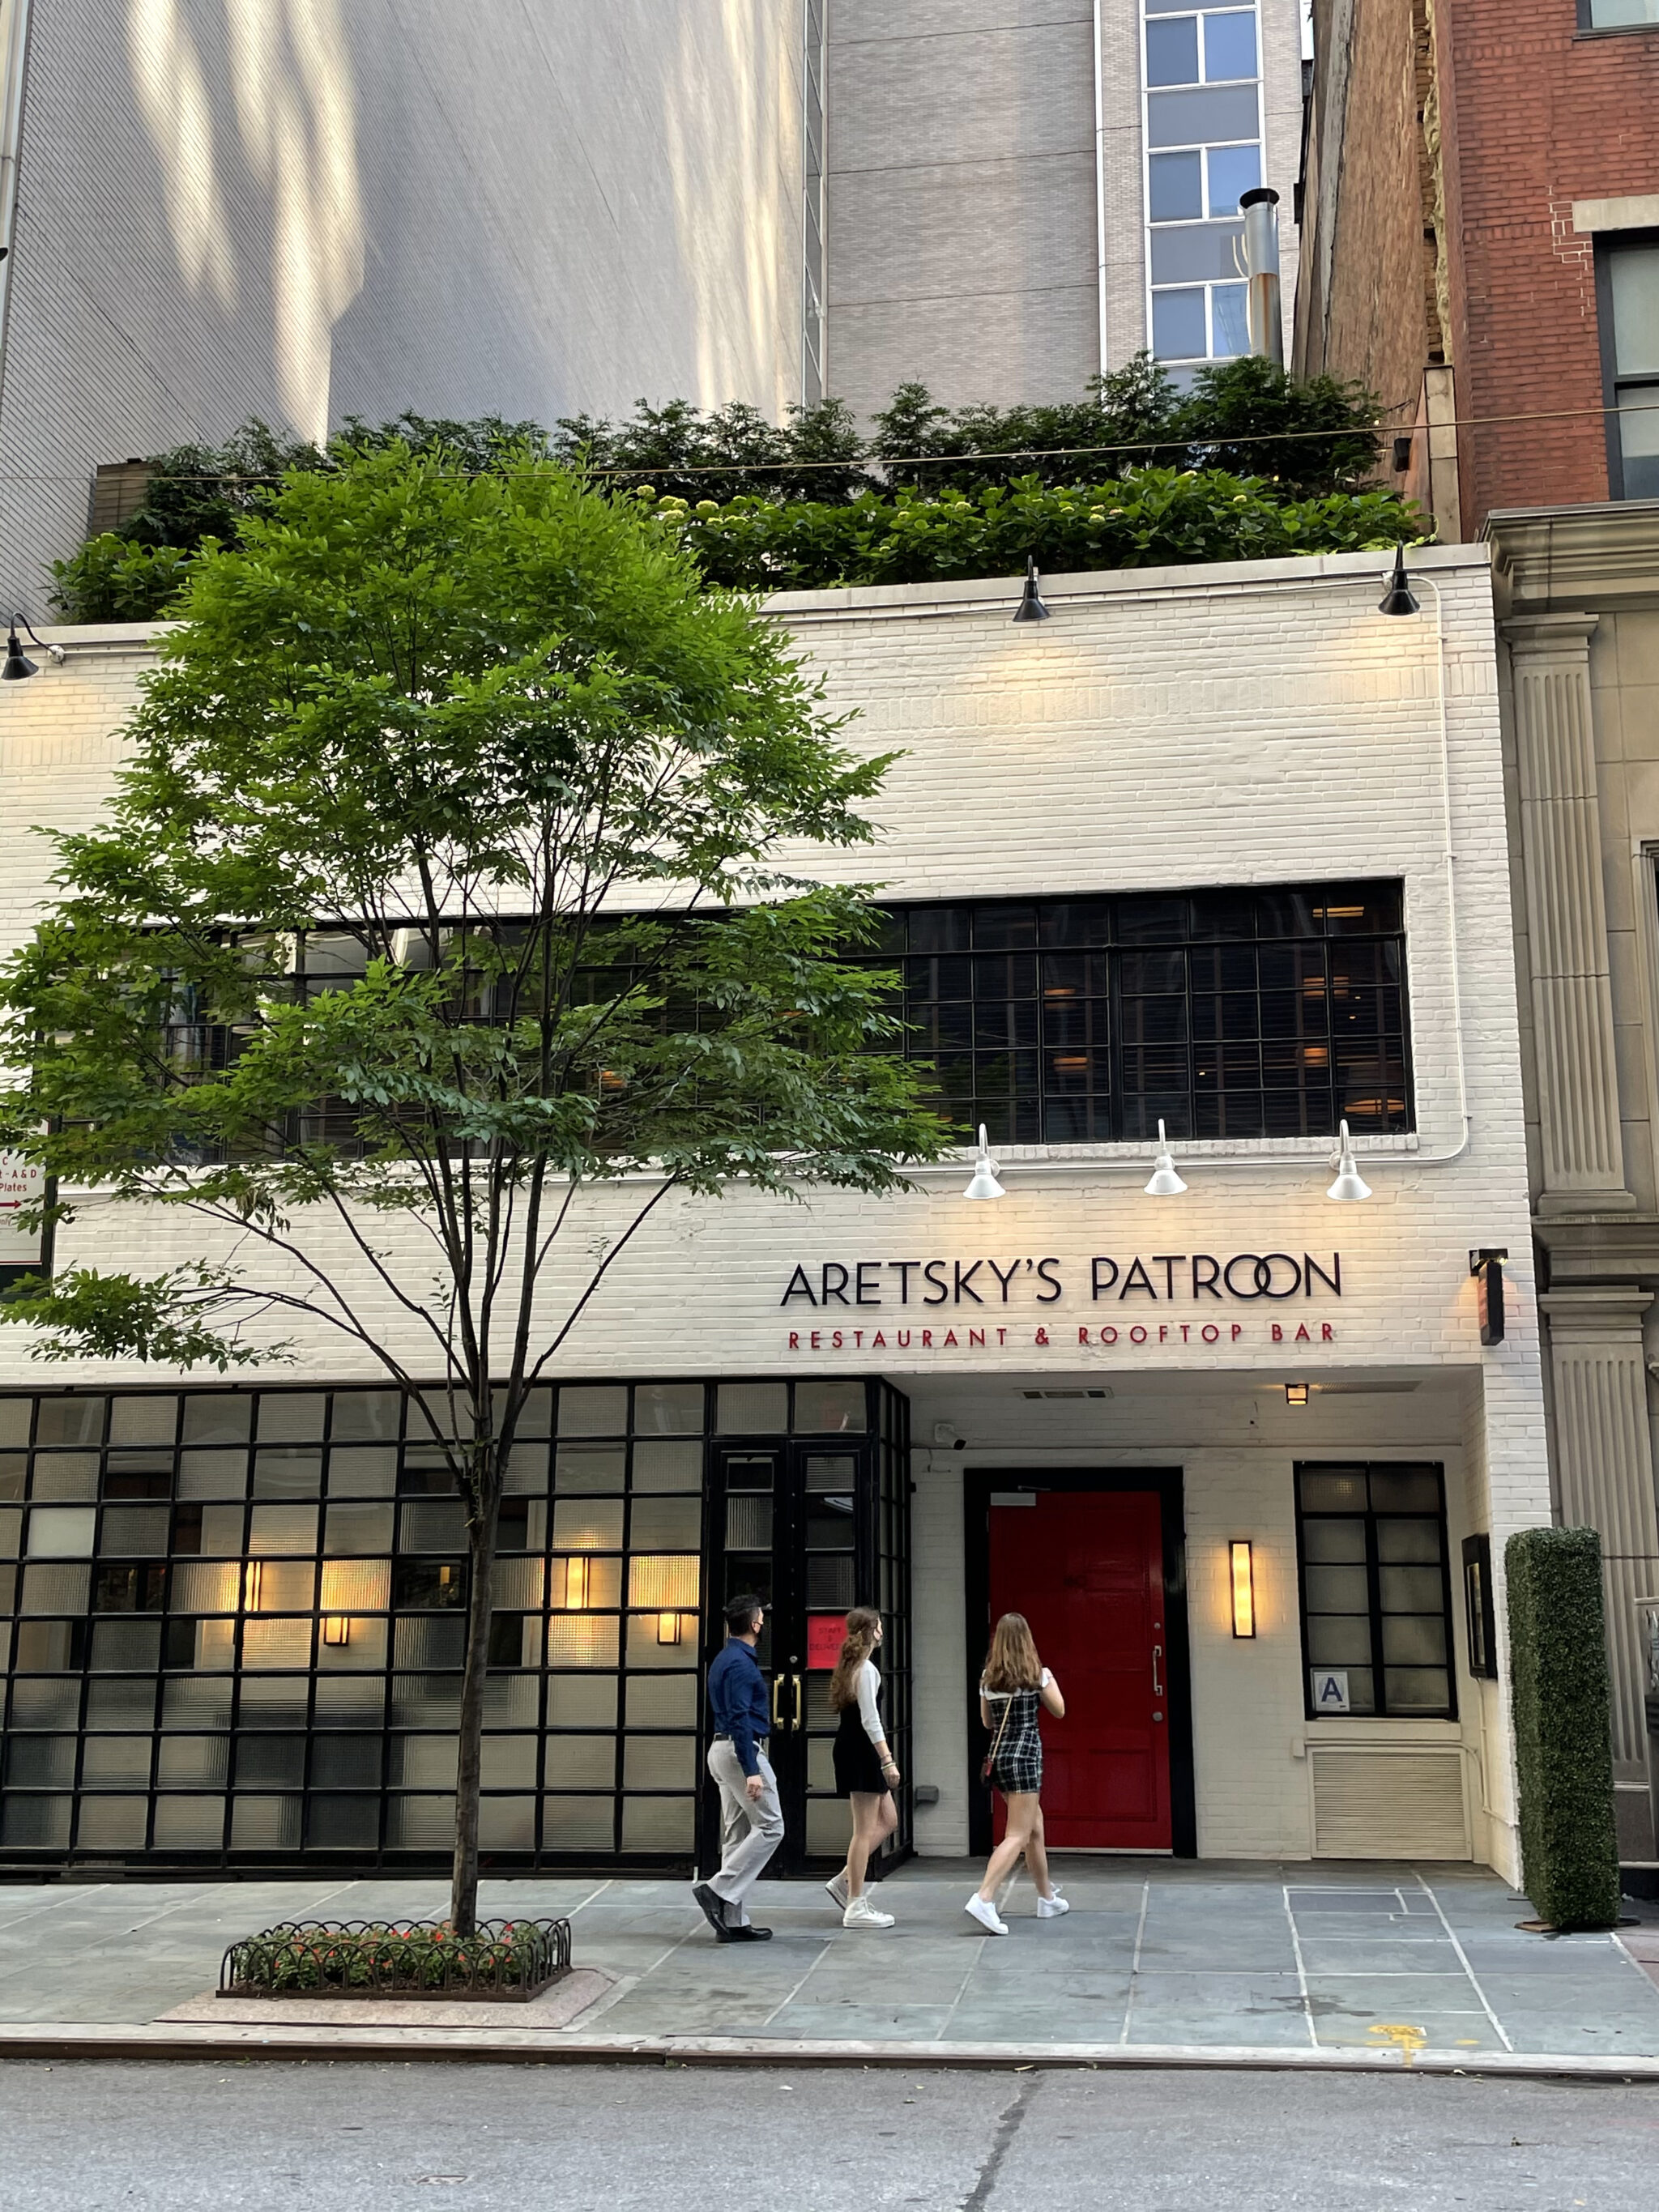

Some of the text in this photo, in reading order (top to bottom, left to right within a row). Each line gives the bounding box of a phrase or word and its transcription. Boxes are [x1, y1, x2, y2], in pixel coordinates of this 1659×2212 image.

[12, 1170, 18, 1178] A
[21, 1170, 27, 1178] &
[31, 1170, 36, 1178] D
[779, 1251, 1341, 1306] ARETSKY'S PATROON
[788, 1322, 1333, 1349] RESTAURANT & ROOFTOP BAR
[1321, 1677, 1343, 1702] A
